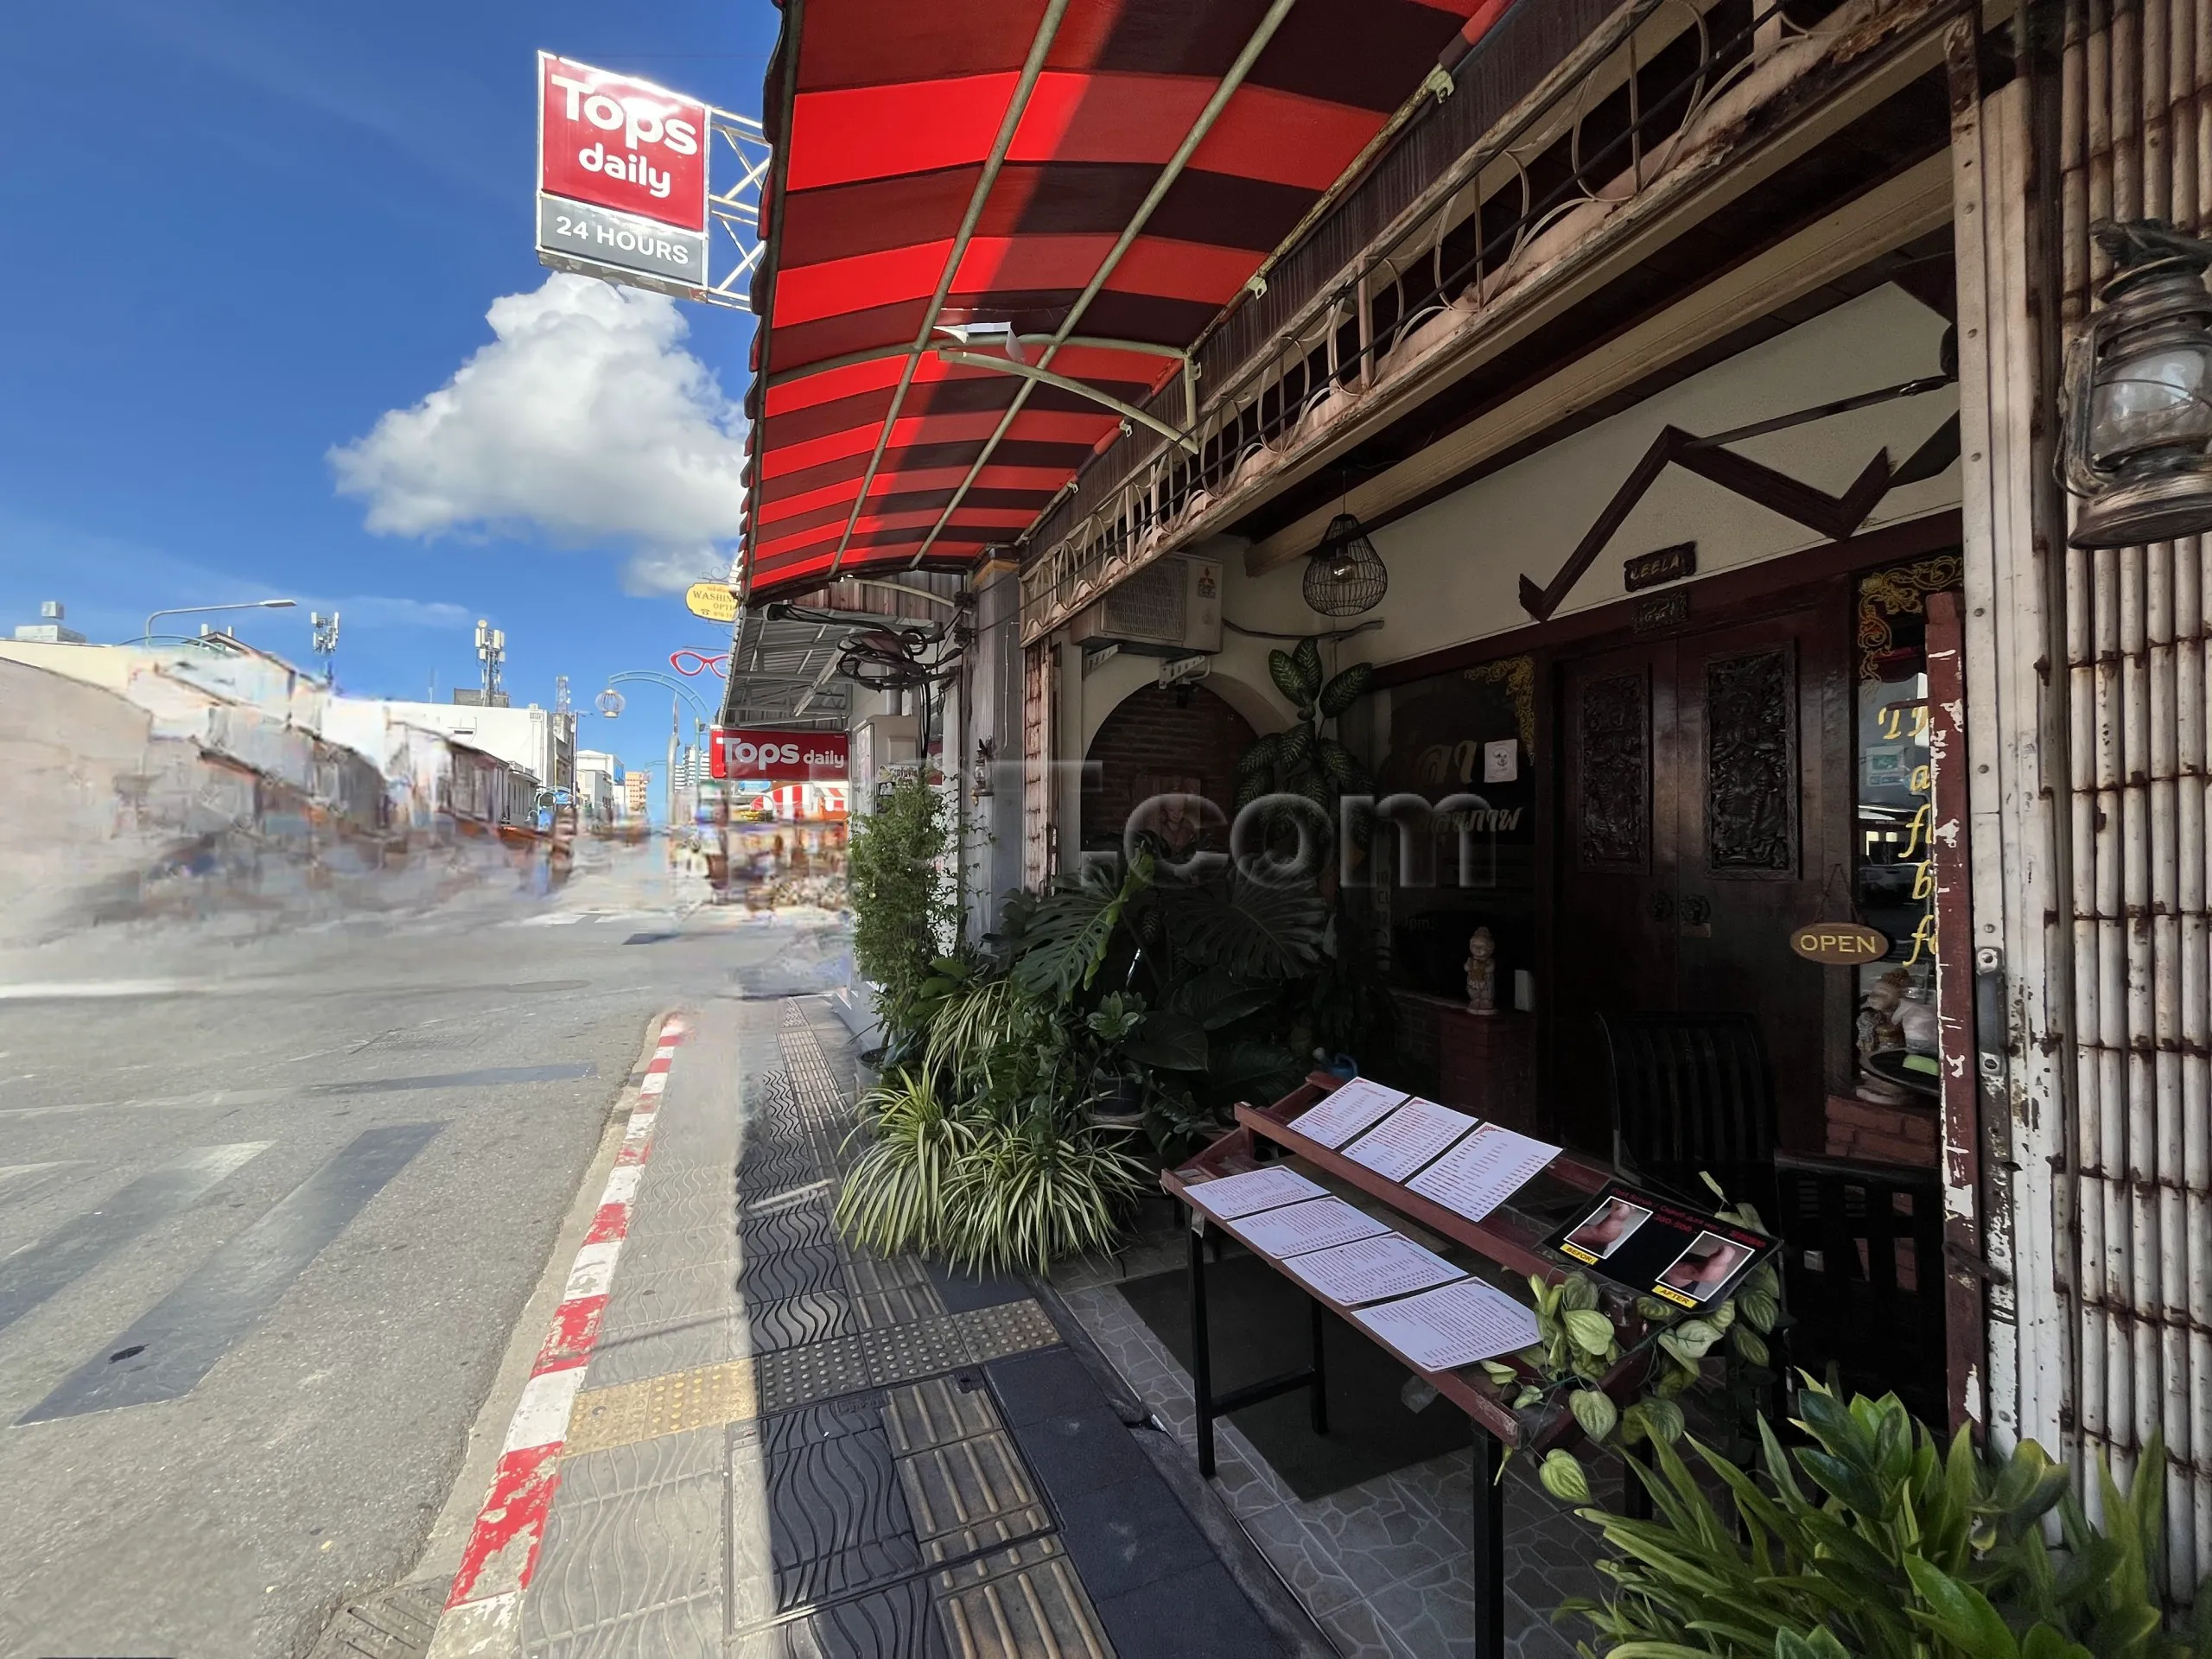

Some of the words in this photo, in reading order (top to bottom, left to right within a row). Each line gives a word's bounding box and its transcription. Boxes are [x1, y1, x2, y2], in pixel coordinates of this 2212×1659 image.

[551, 73, 698, 156] Tops
[578, 143, 671, 198] daily
[556, 216, 588, 239] 24
[596, 225, 689, 264] HOURS
[692, 590, 736, 603] WASHIN
[715, 737, 800, 771] Tops
[803, 749, 844, 768] daily
[1800, 934, 1877, 953] OPEN
[1565, 1246, 1594, 1264] BEFOR
[1659, 1287, 1691, 1305] AFTER
